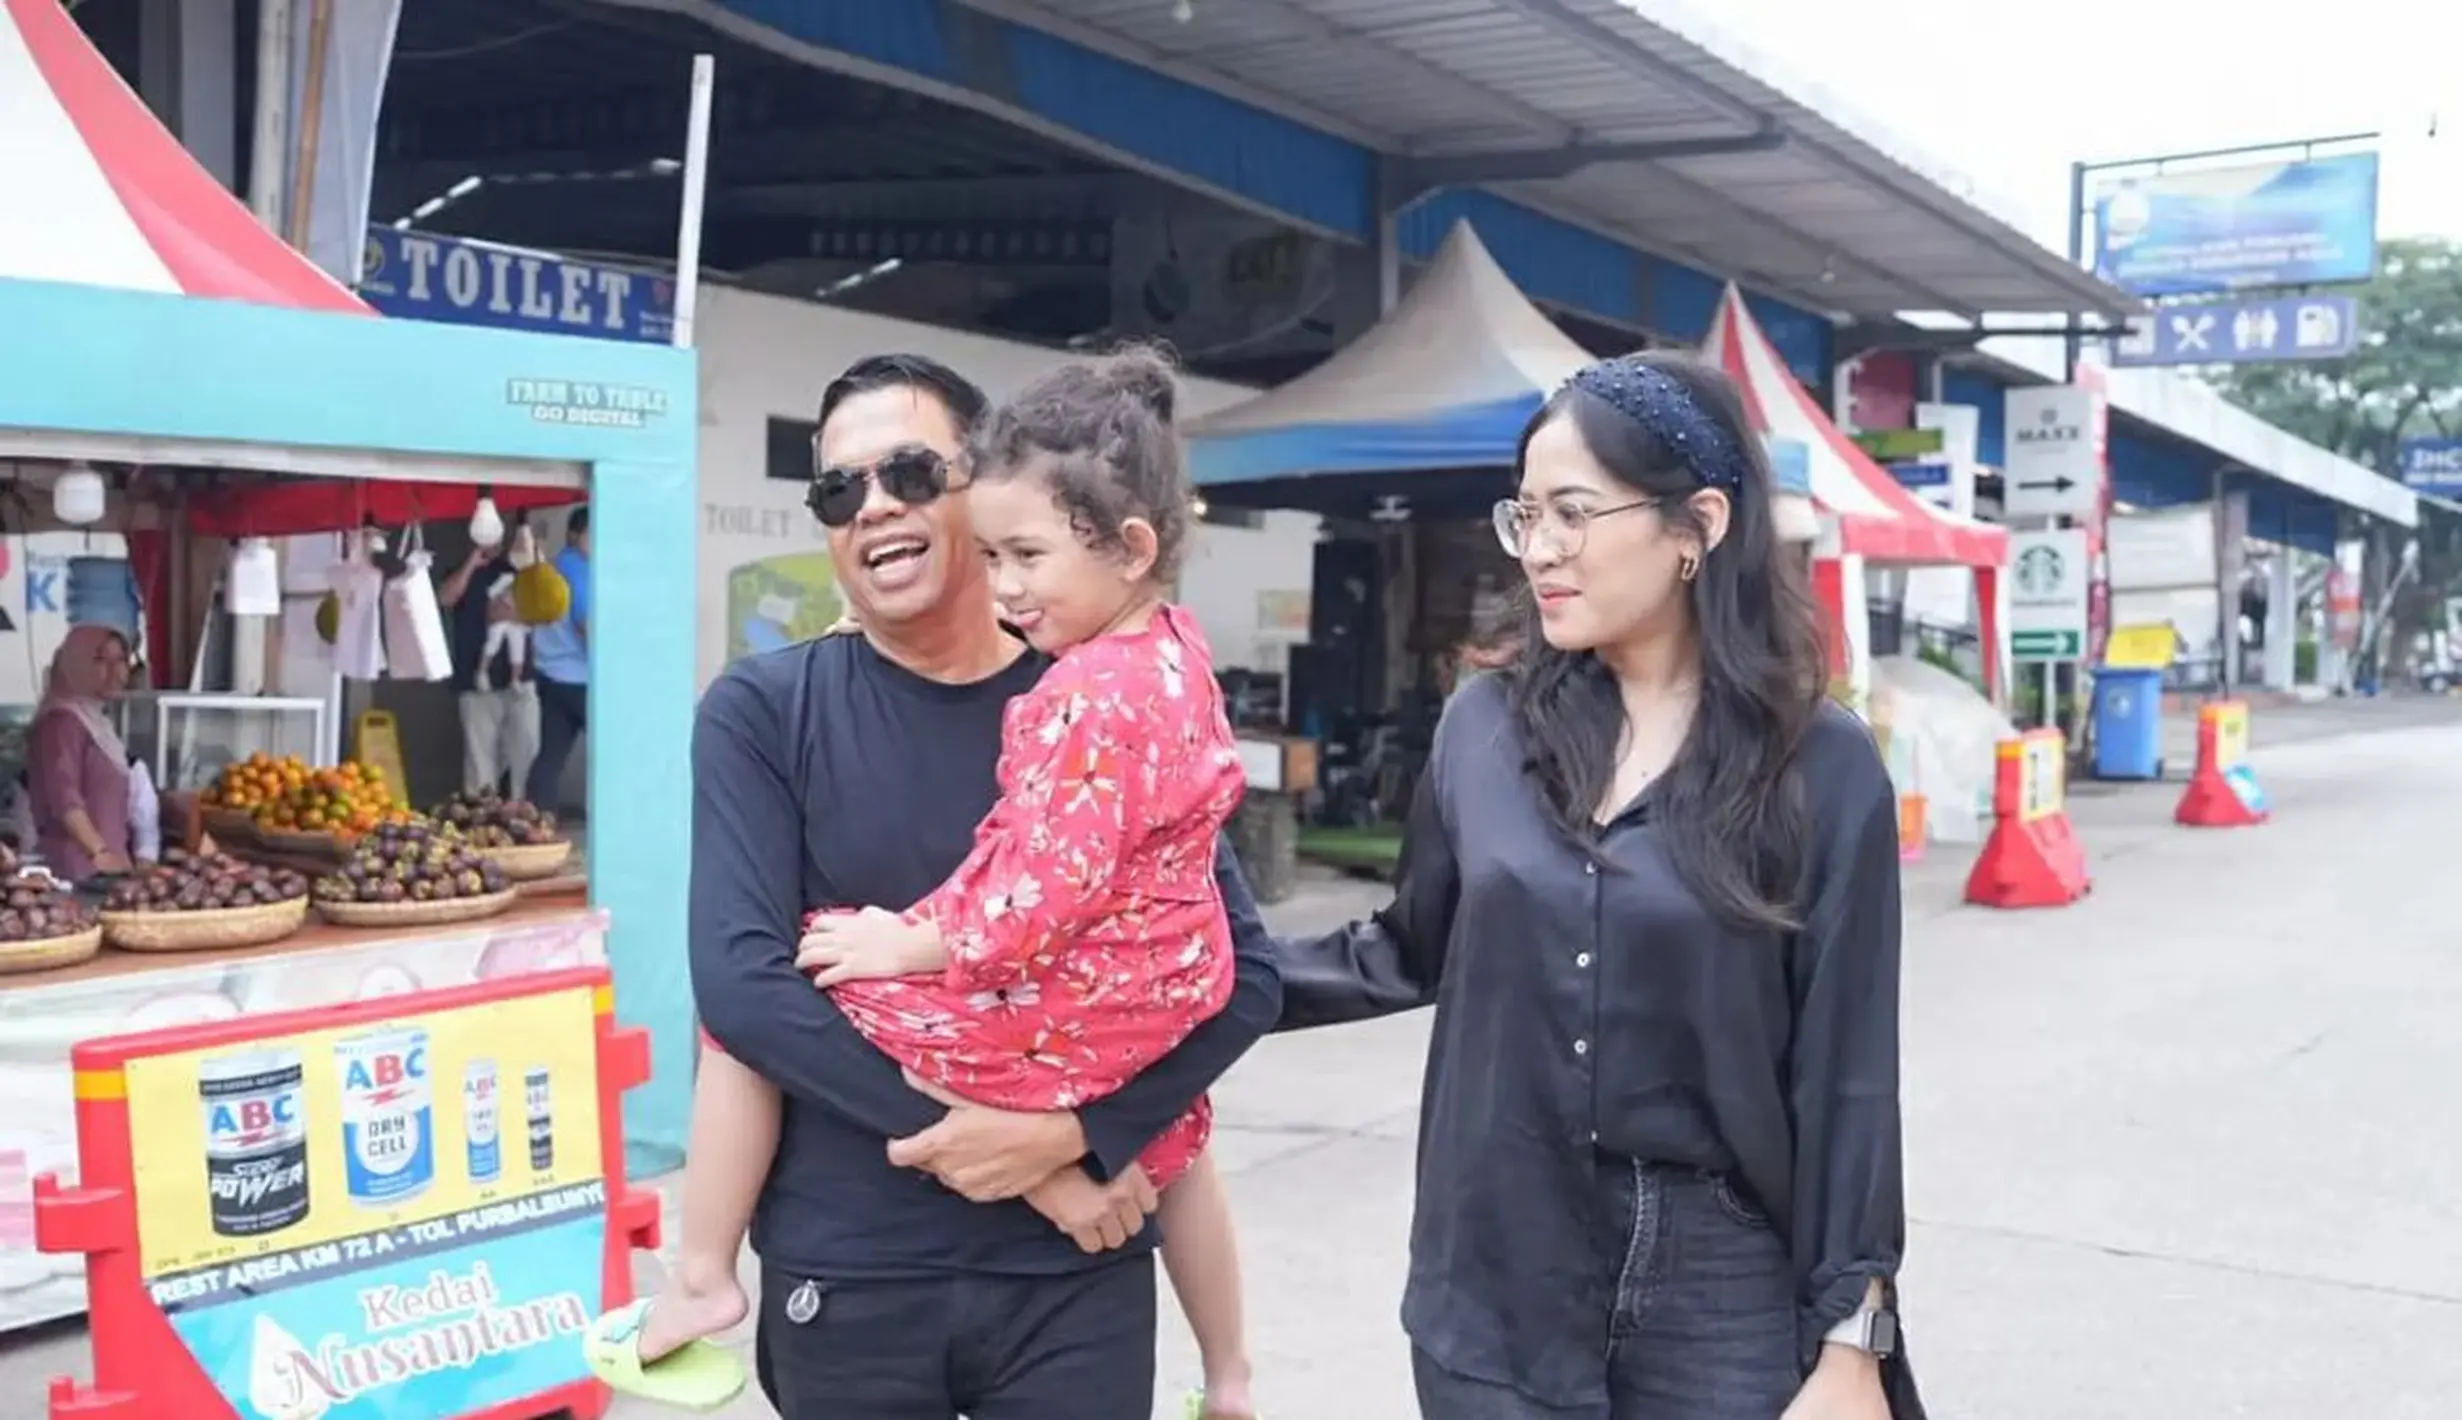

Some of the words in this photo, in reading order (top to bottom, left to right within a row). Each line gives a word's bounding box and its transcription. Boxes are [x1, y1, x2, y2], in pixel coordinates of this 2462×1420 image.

[402, 238, 631, 329] TOILET
[572, 383, 601, 406] TO
[705, 503, 790, 538] TOILET
[347, 1047, 426, 1091] ABC
[211, 1093, 295, 1134] ABC
[367, 1115, 407, 1138] DRY
[367, 1136, 407, 1157] CELL
[209, 1161, 305, 1209] POWER
[151, 1270, 223, 1305] REST
[226, 1253, 299, 1288] AREA
[299, 1246, 340, 1271] KM
[341, 1237, 374, 1260] 72
[375, 1232, 396, 1254] A
[407, 1219, 456, 1245] TOL
[362, 1260, 499, 1331] Kedai
[268, 1293, 589, 1405] Nusantara
